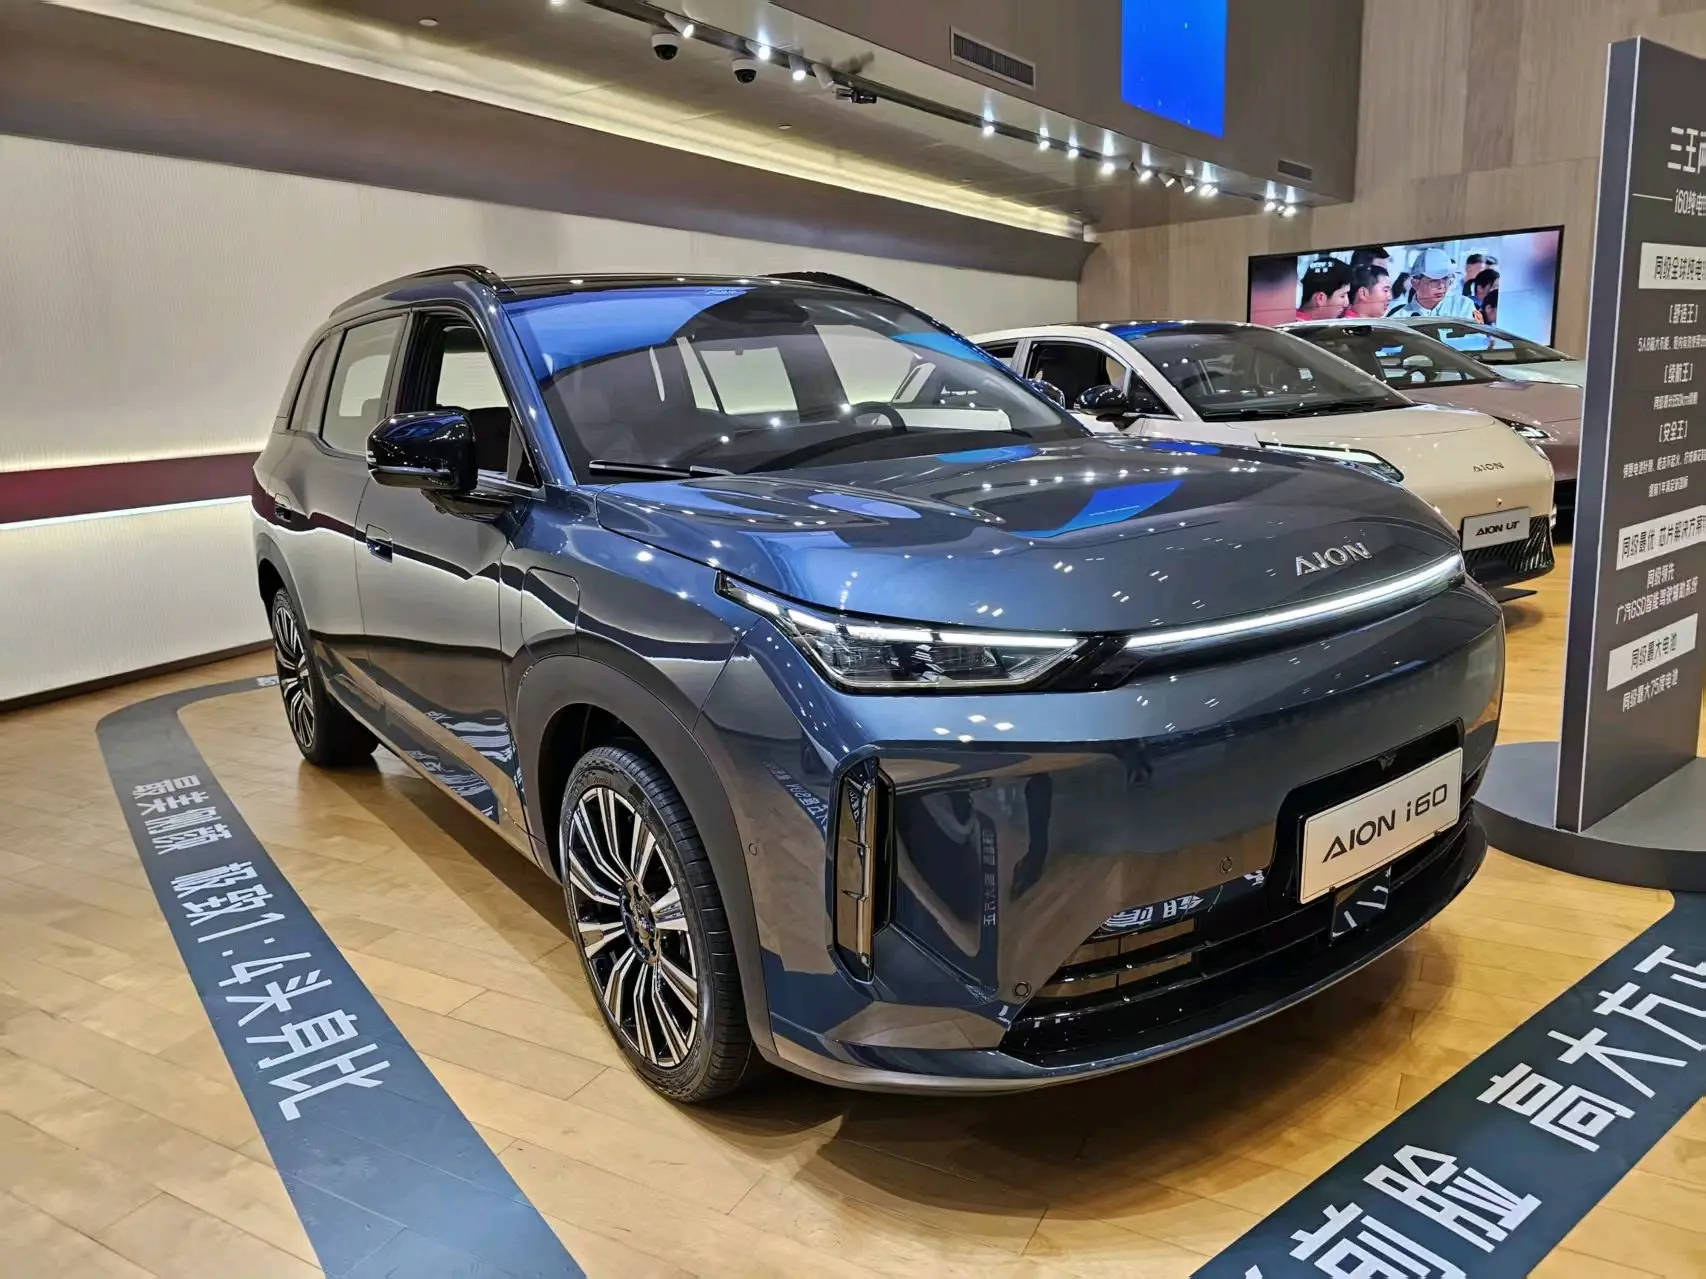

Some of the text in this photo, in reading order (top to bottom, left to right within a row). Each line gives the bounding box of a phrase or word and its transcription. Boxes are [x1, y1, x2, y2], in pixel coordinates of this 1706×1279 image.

[1473, 462, 1504, 473] AION
[1475, 520, 1520, 536] AION UT
[1296, 542, 1372, 576] AION
[1322, 783, 1447, 864] AION i60
[1245, 1145, 1542, 1279] 前脸
